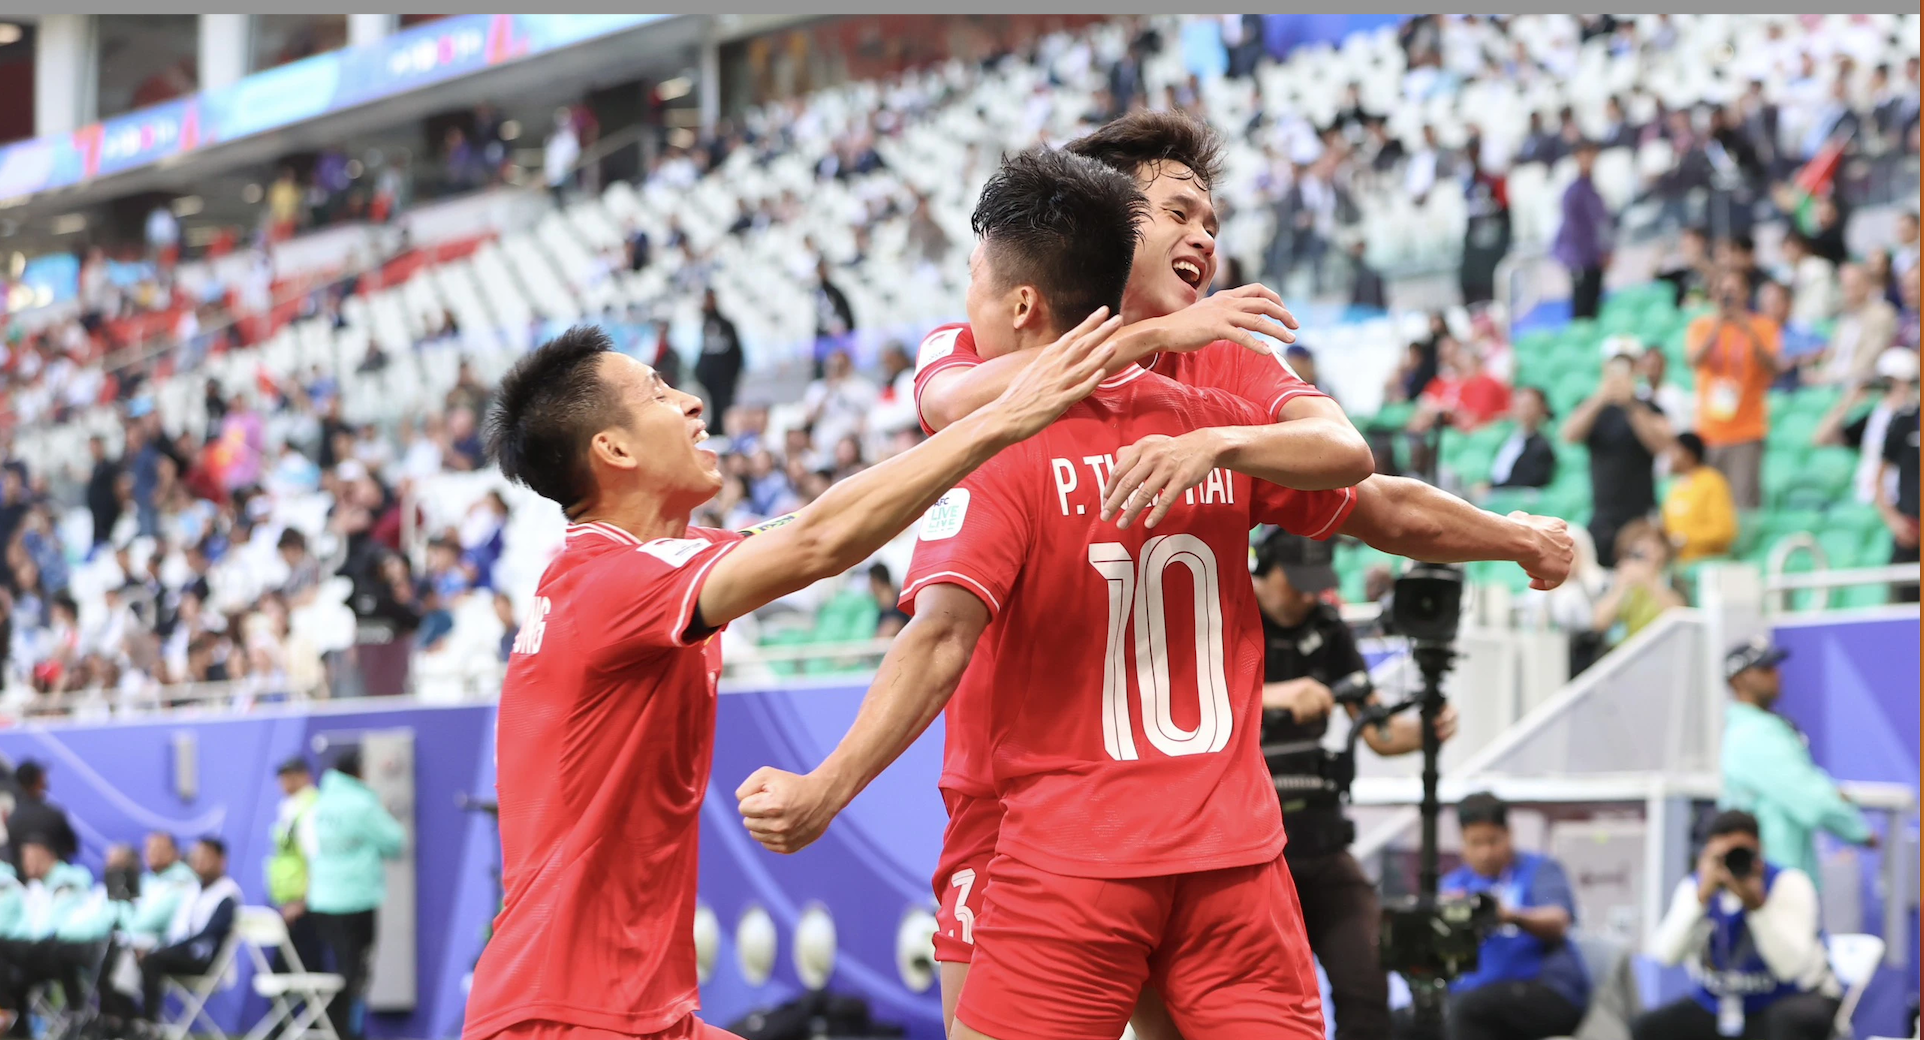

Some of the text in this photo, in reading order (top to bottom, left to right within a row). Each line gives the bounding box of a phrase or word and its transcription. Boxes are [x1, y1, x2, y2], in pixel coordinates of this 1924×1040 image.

[931, 505, 960, 520] LIVE
[1051, 457, 1086, 516] P.
[1088, 533, 1234, 761] 10
